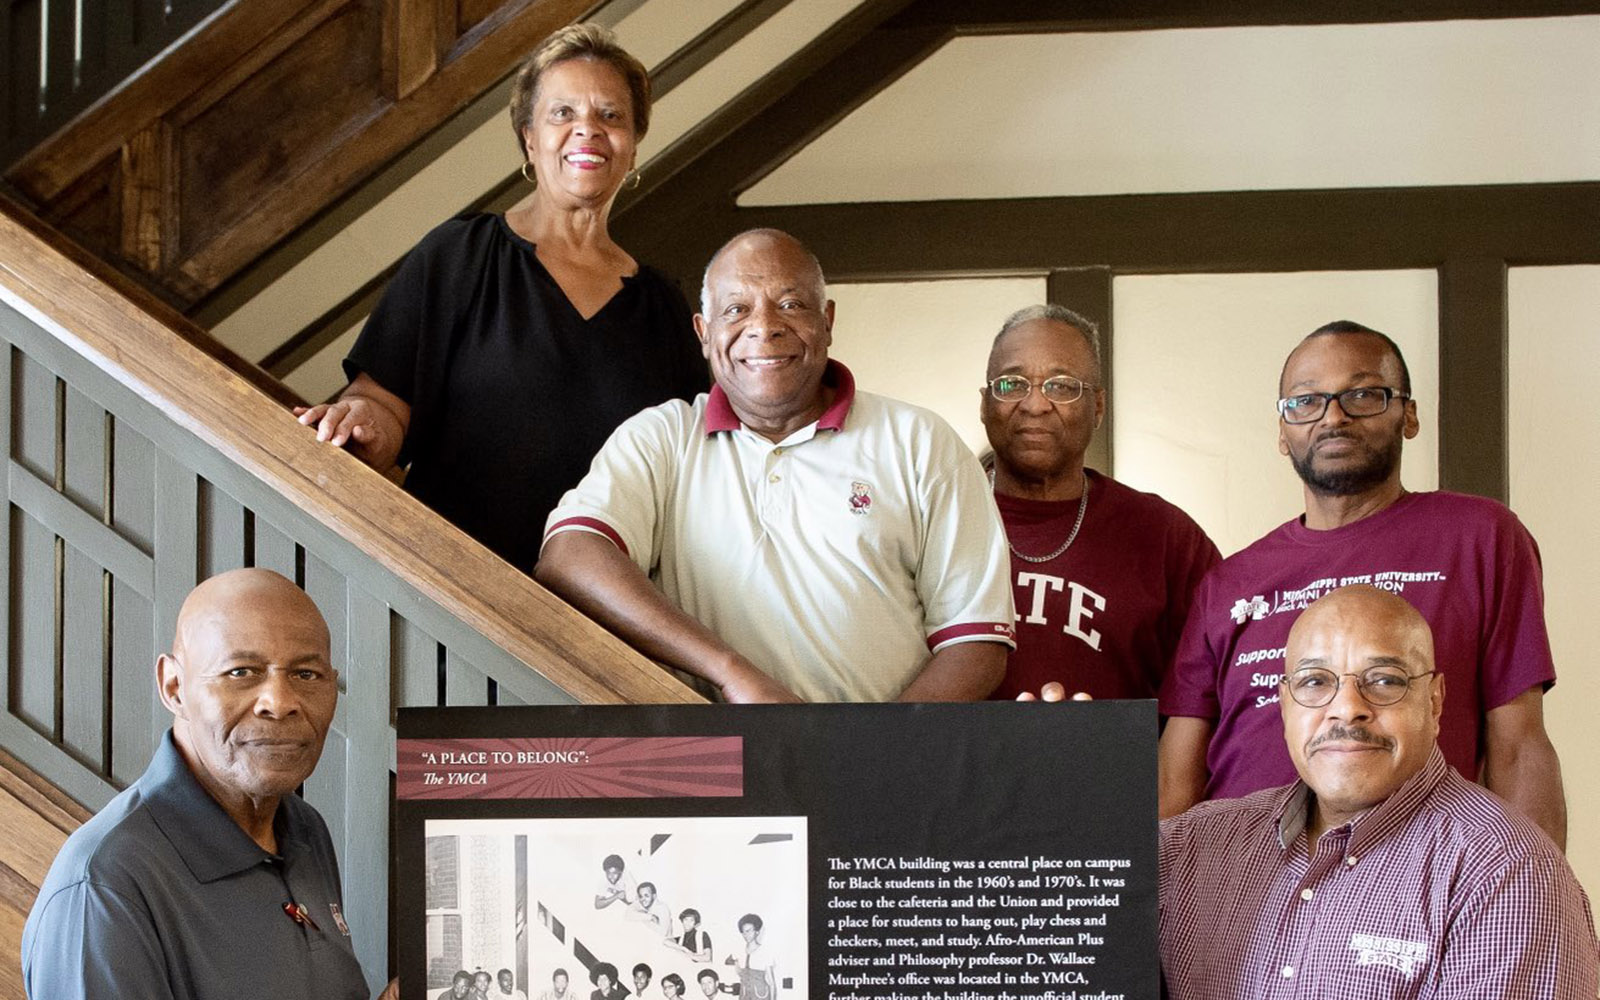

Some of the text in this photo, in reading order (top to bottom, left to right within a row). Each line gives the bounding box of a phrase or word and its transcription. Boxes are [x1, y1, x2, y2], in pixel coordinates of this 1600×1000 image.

[1340, 575, 1372, 587] STATE
[1375, 571, 1441, 582] UNIVERSITY
[441, 752, 488, 764] PLACE
[491, 752, 513, 764] TO
[424, 772, 487, 785] The YMCA
[827, 855, 1131, 873] The YMCA building was a central place on campus
[828, 876, 847, 890] for
[849, 876, 883, 889] Black
[884, 876, 935, 889] students
[938, 877, 951, 889] in
[953, 875, 974, 889] the
[1017, 875, 1041, 888] and
[1089, 875, 1100, 888] It
[1102, 878, 1126, 887] was
[827, 893, 1120, 911] close to the cafeteria and the Union and provided
[827, 913, 1107, 931] a place for students to hang out, play chess and
[827, 932, 1105, 950] checkers, meet, and study. Afro-American Plus
[828, 952, 1096, 969] adviser and Philosophy professor Dr. Wallace
[1367, 953, 1406, 969] STATE
[897, 972, 931, 985] office
[932, 976, 956, 985] was
[958, 971, 1002, 985] located
[1004, 972, 1017, 984] in
[1019, 971, 1040, 984] the
[1041, 971, 1089, 985] YMCA,
